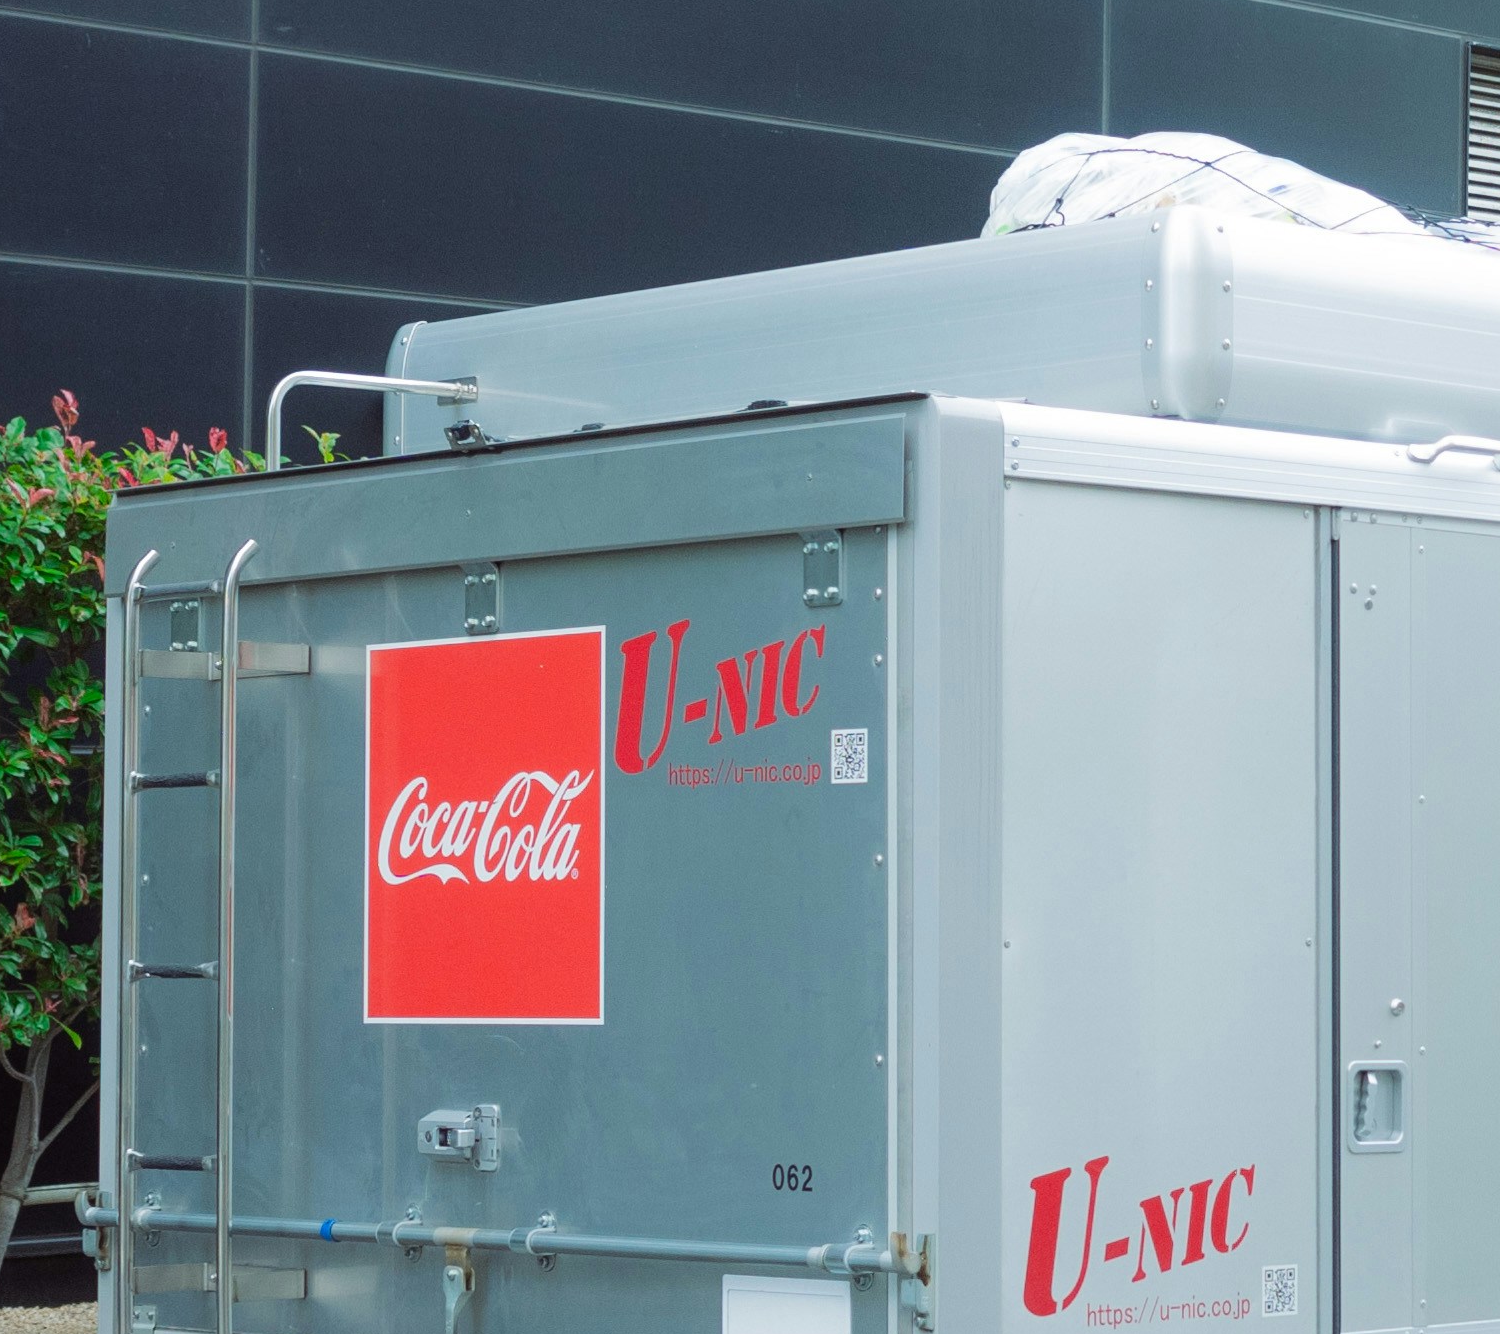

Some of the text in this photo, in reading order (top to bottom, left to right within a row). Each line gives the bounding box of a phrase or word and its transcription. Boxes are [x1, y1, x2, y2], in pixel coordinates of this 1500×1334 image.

[615, 620, 826, 774] U-NIC
[668, 759, 822, 788] https://u-nic.co.jp
[378, 769, 595, 885] Coca-Cola
[772, 1163, 813, 1192] 062
[1024, 1156, 1255, 1317] U-NIC
[1086, 1293, 1252, 1328] https://u-nic.co.jp
